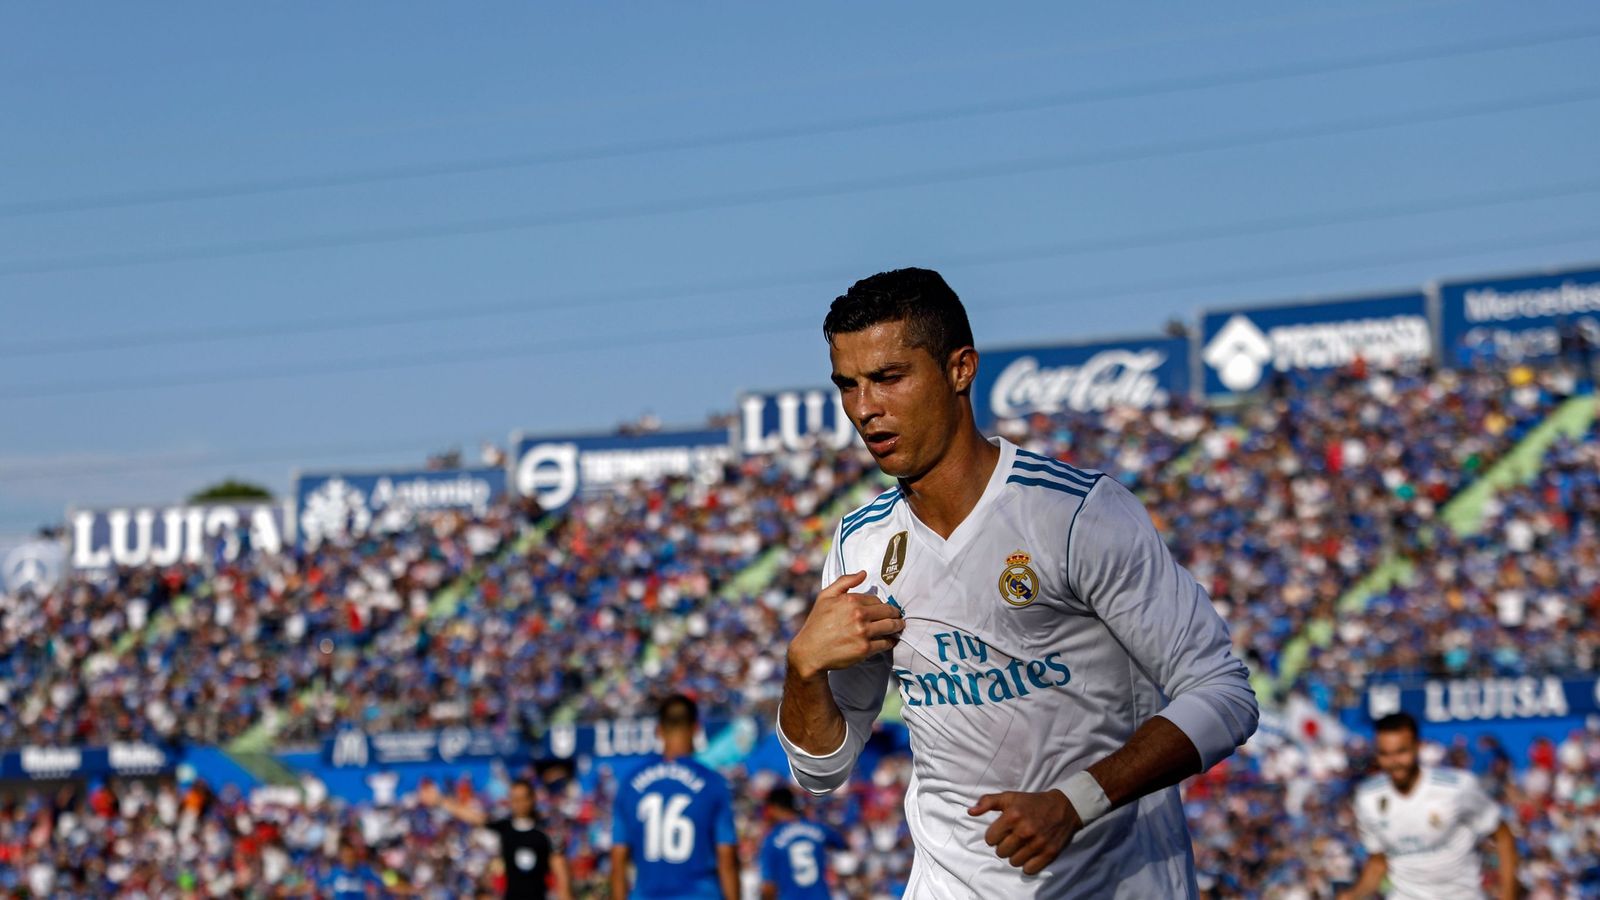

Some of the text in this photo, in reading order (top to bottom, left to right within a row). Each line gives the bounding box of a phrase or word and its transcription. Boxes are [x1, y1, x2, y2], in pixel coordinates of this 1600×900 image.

[934, 630, 988, 663] Fly
[893, 652, 1071, 707] Emirates
[1425, 675, 1568, 721] LUJISA
[636, 792, 695, 864] 16
[789, 840, 819, 887] 5
